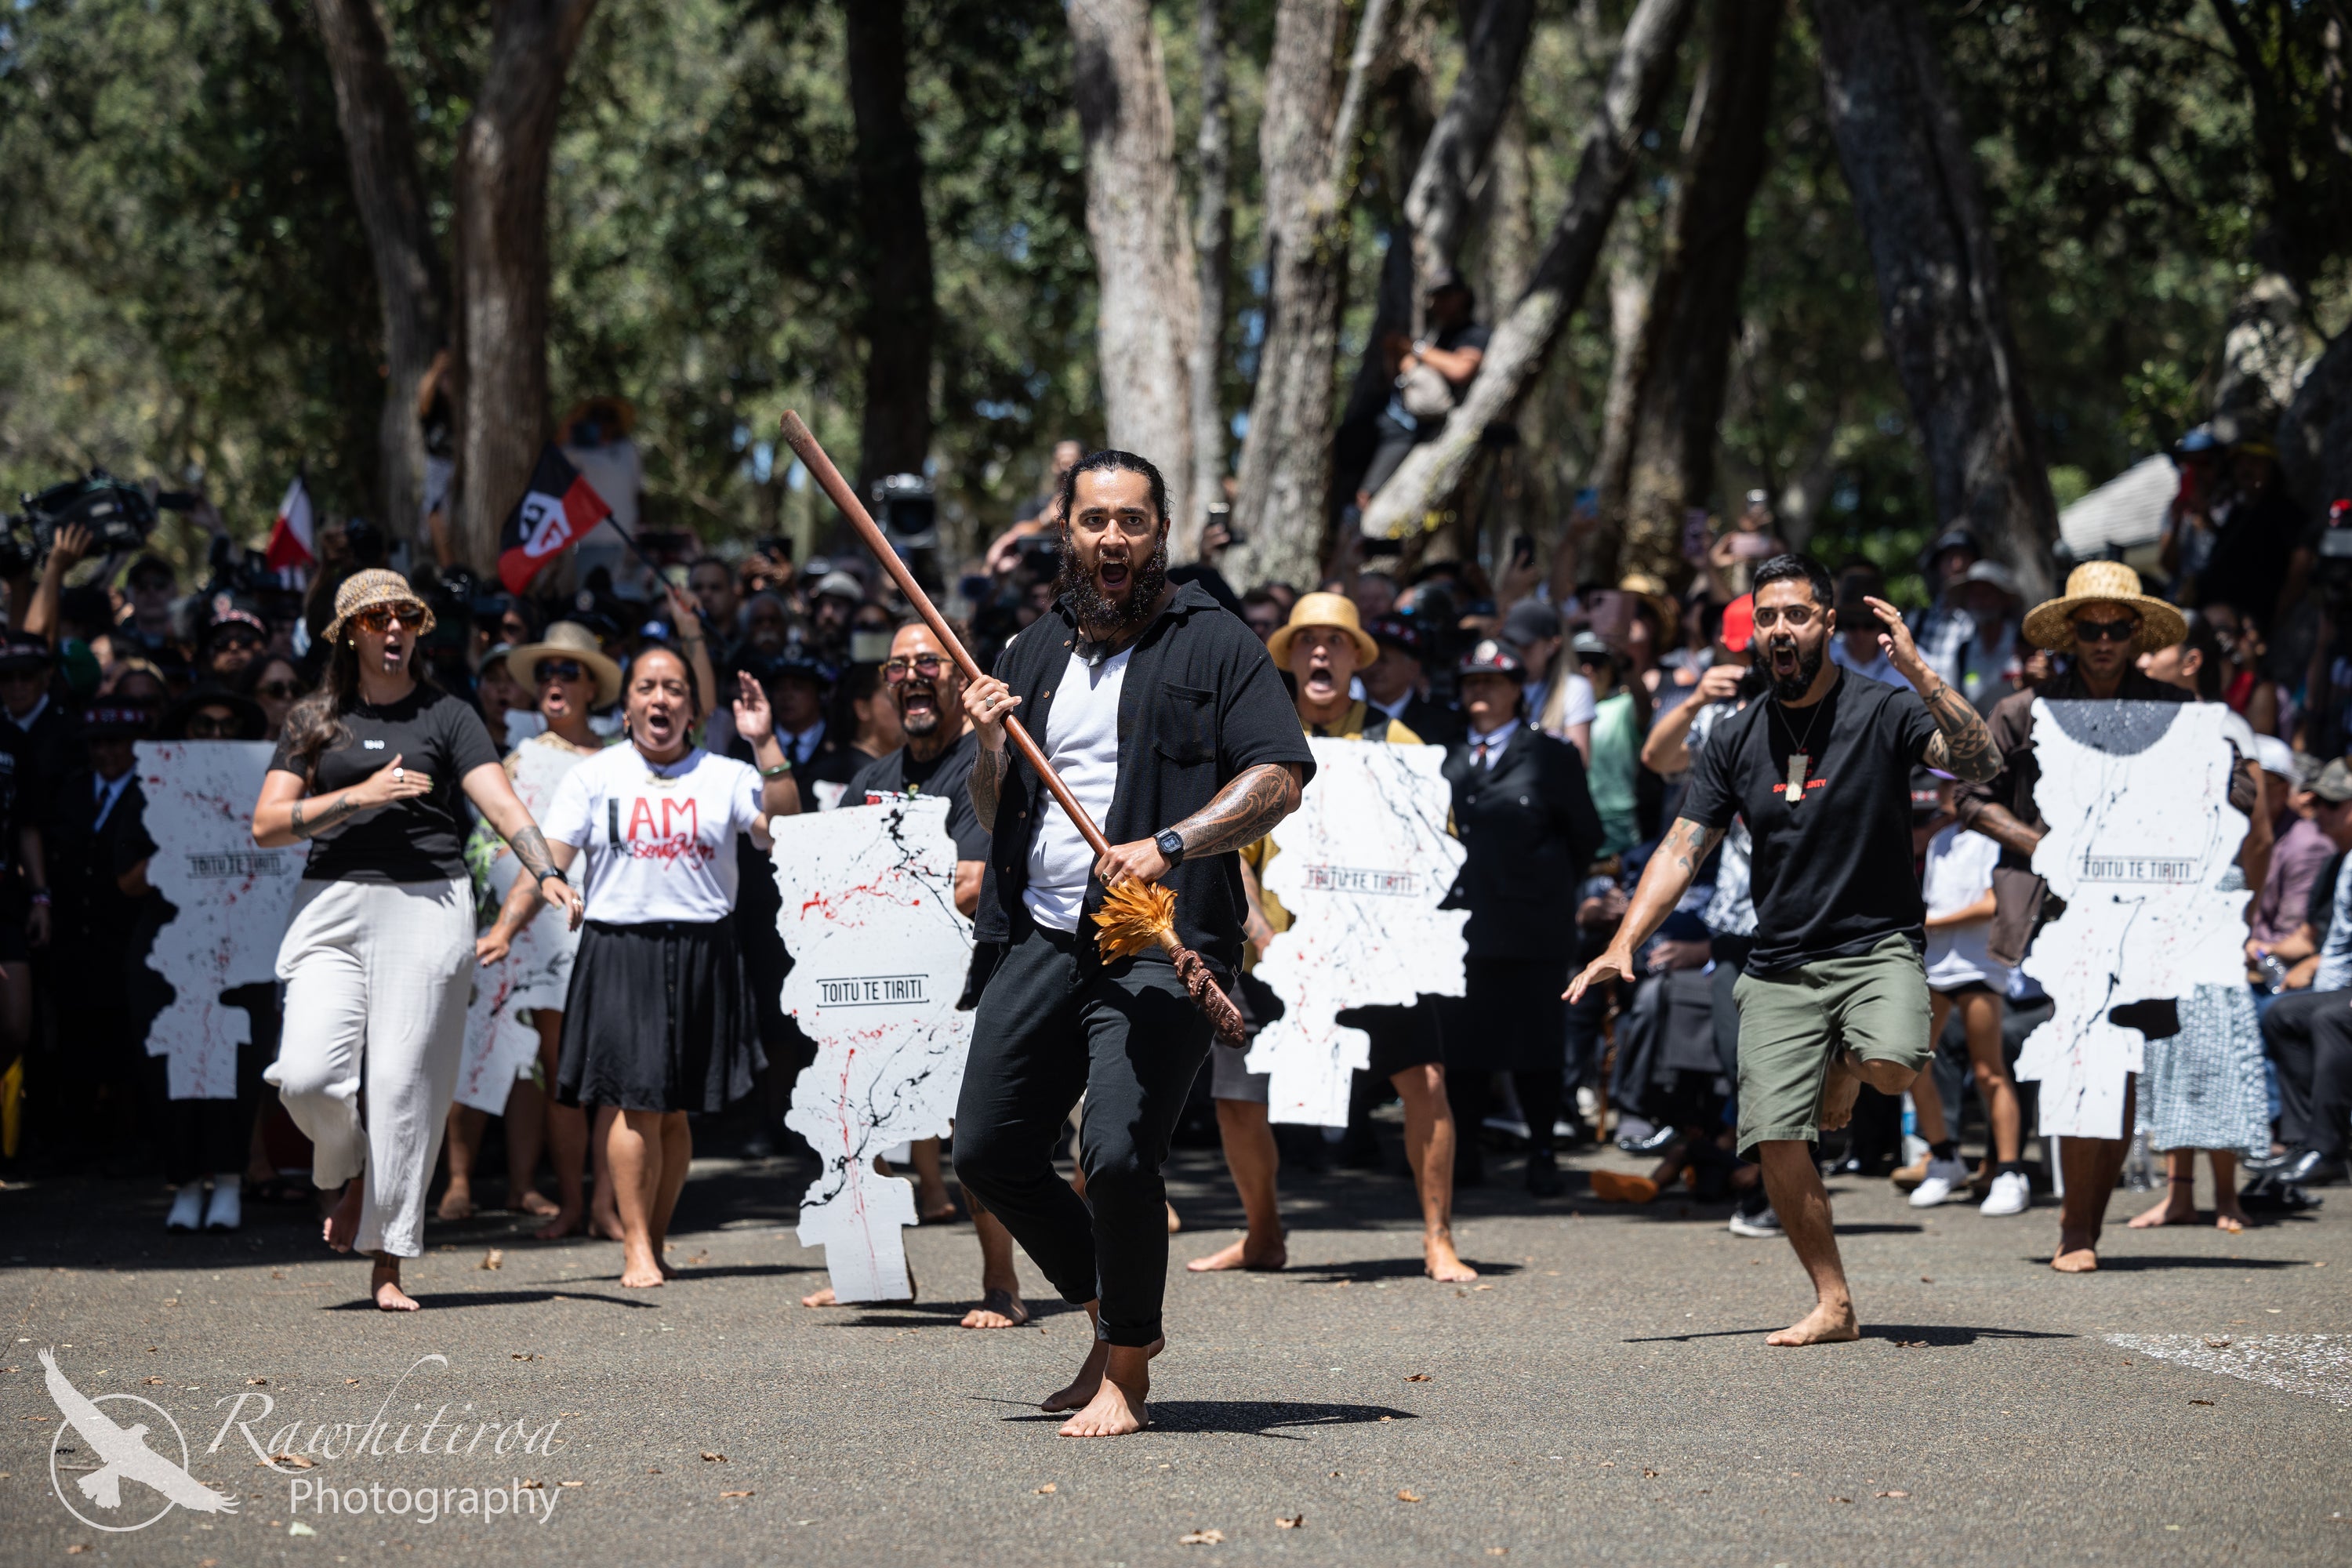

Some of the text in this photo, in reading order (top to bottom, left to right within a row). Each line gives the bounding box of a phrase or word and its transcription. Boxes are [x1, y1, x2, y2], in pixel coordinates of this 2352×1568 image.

[608, 797, 698, 843] I AM
[2130, 862, 2143, 878] TE
[2151, 862, 2190, 878] TIRITI
[1352, 873, 1367, 890] TE
[863, 982, 880, 1000] TE
[884, 979, 922, 1000] TIRITI
